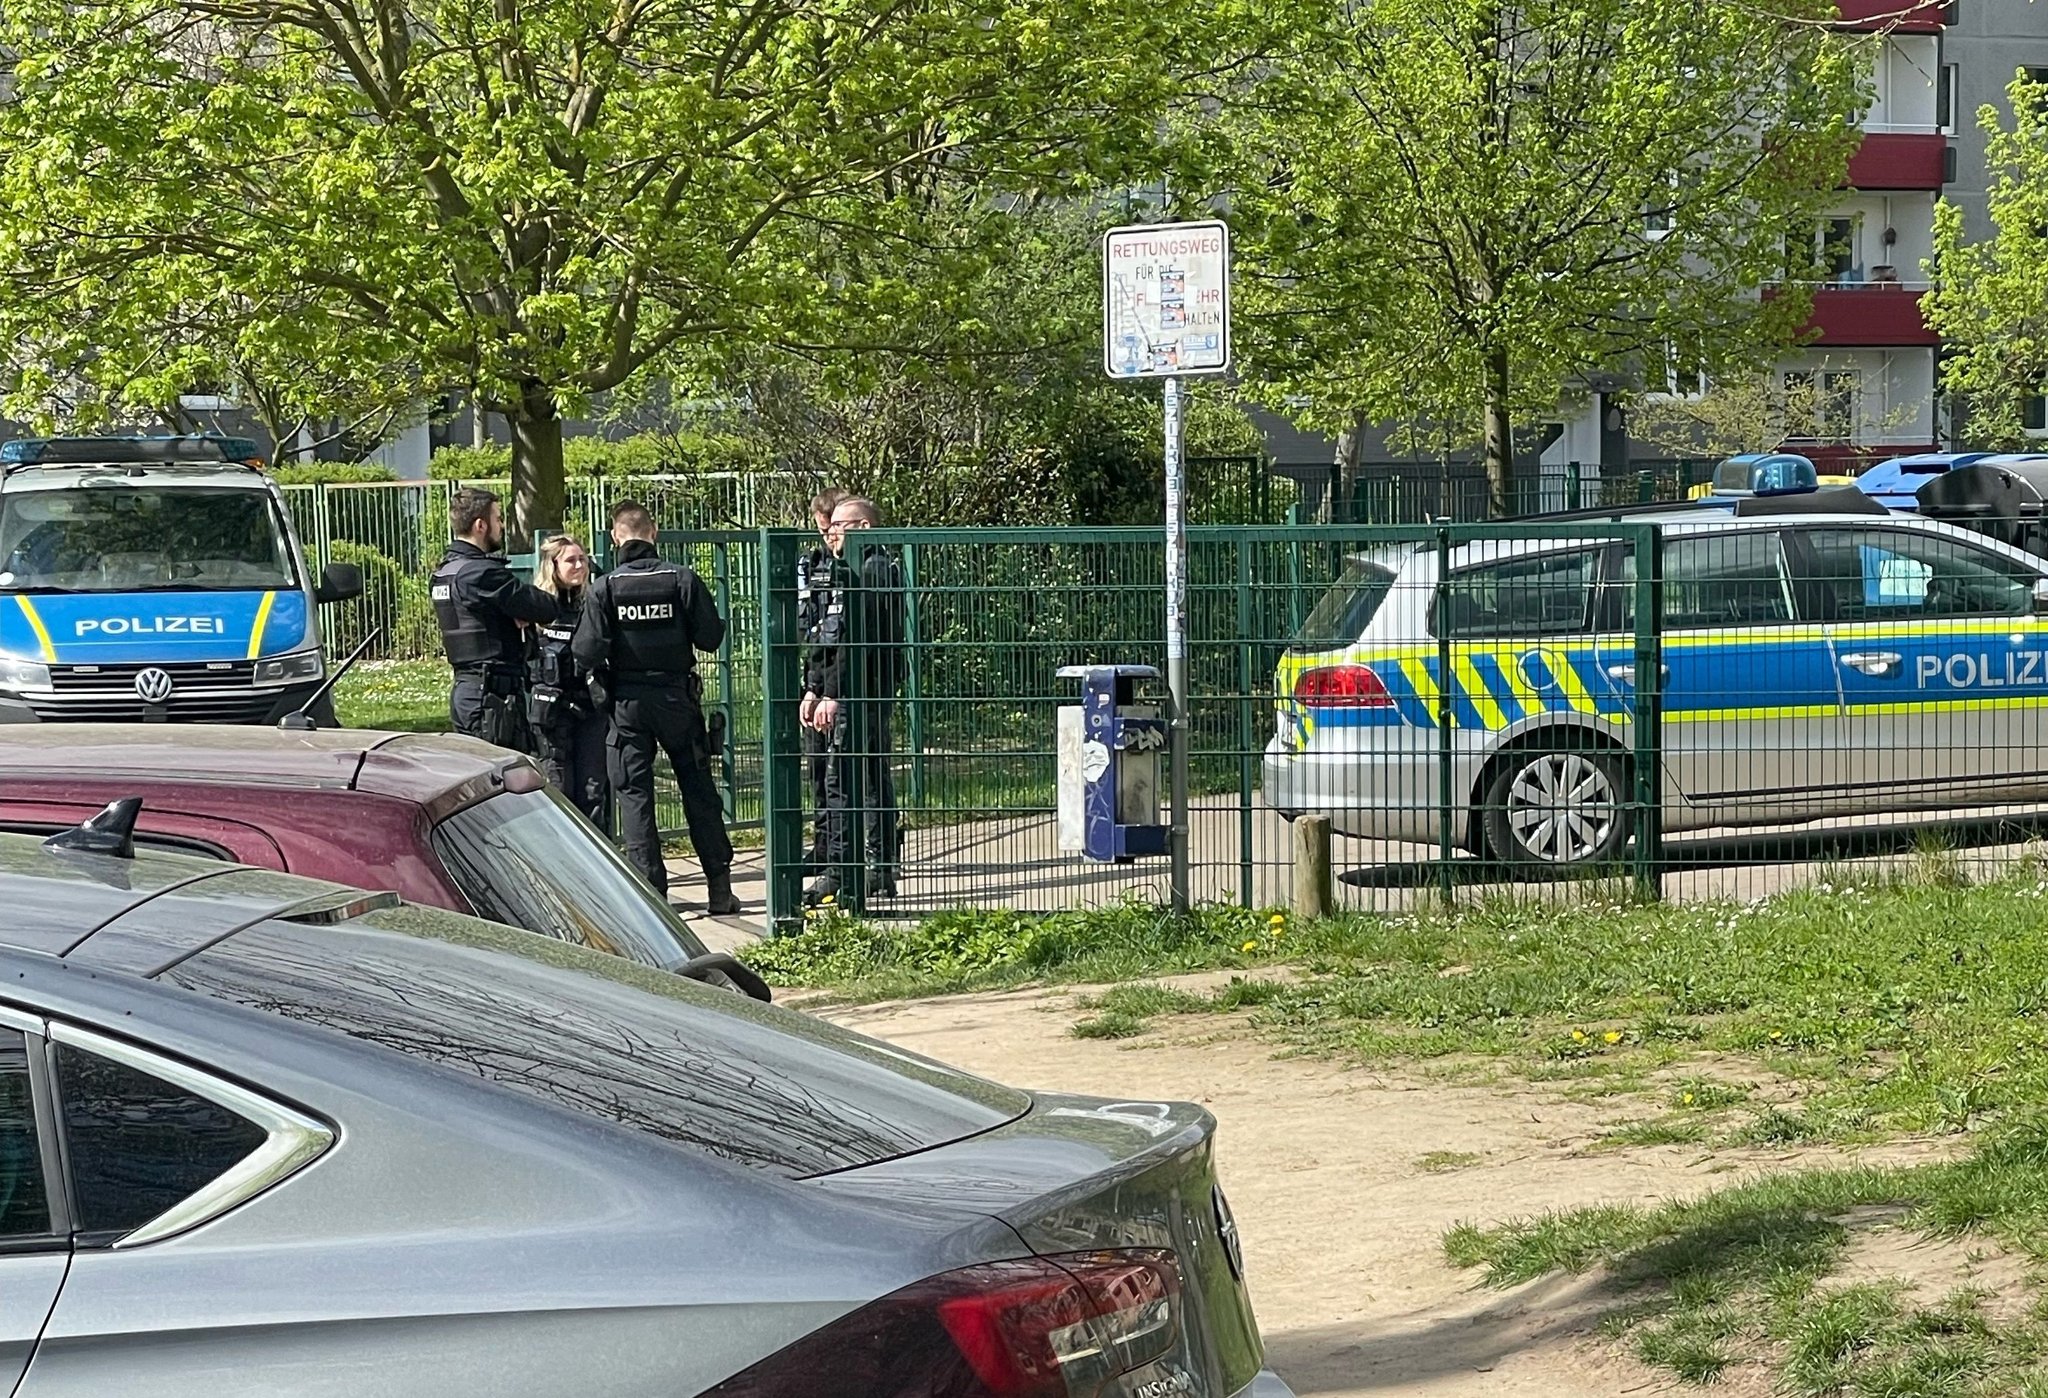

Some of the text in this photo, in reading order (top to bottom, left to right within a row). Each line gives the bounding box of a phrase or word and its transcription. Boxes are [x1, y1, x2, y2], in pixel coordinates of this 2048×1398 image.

[1113, 239, 1219, 258] RETTUNGSWEG
[1136, 264, 1153, 280] FÜR
[618, 603, 673, 621] POLIZEI
[75, 617, 224, 637] POLIZEI
[543, 628, 571, 640] POLIZEI
[1916, 649, 2048, 689] POLIZ
